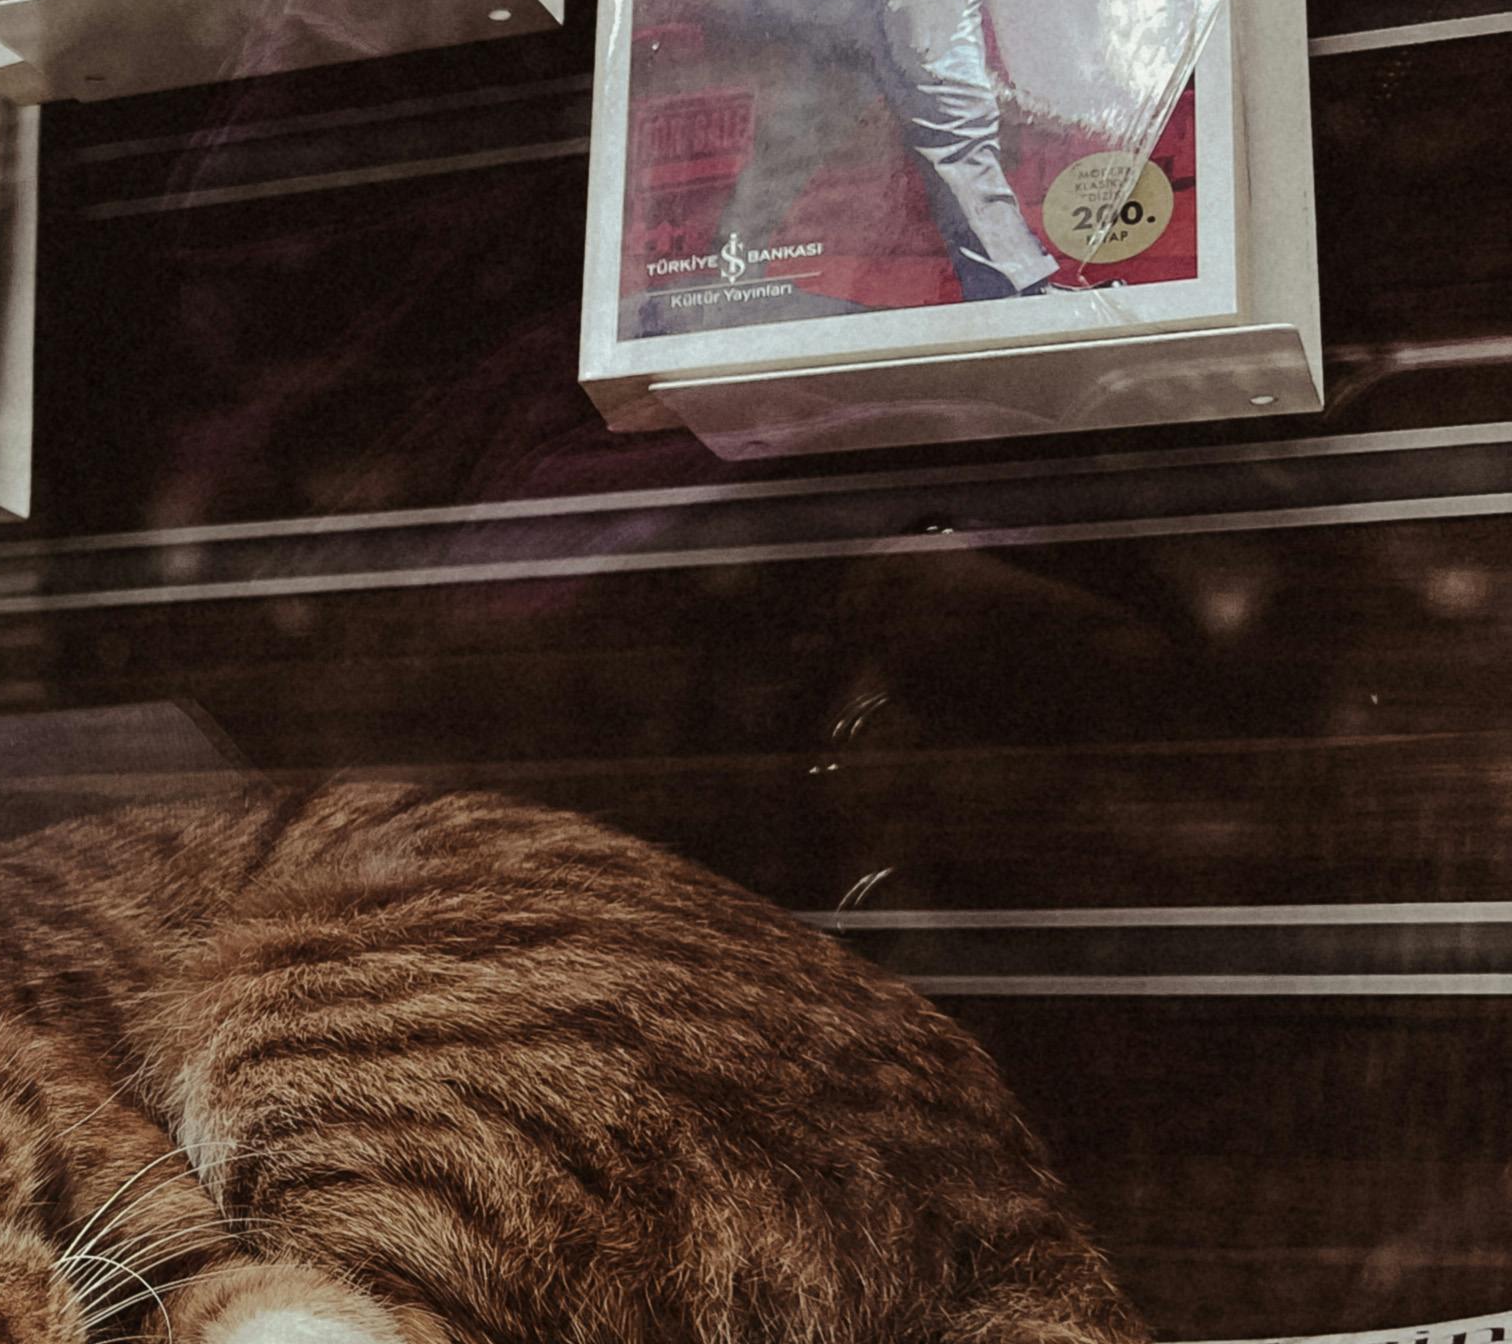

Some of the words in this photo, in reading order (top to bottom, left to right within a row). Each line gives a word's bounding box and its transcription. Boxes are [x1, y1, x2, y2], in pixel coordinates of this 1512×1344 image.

[1085, 230, 1129, 245] KAP
[646, 253, 719, 277] TÜRKİYE
[747, 242, 824, 265] BANKASI
[670, 288, 721, 309] Kültür
[723, 283, 793, 304] Yayınları
